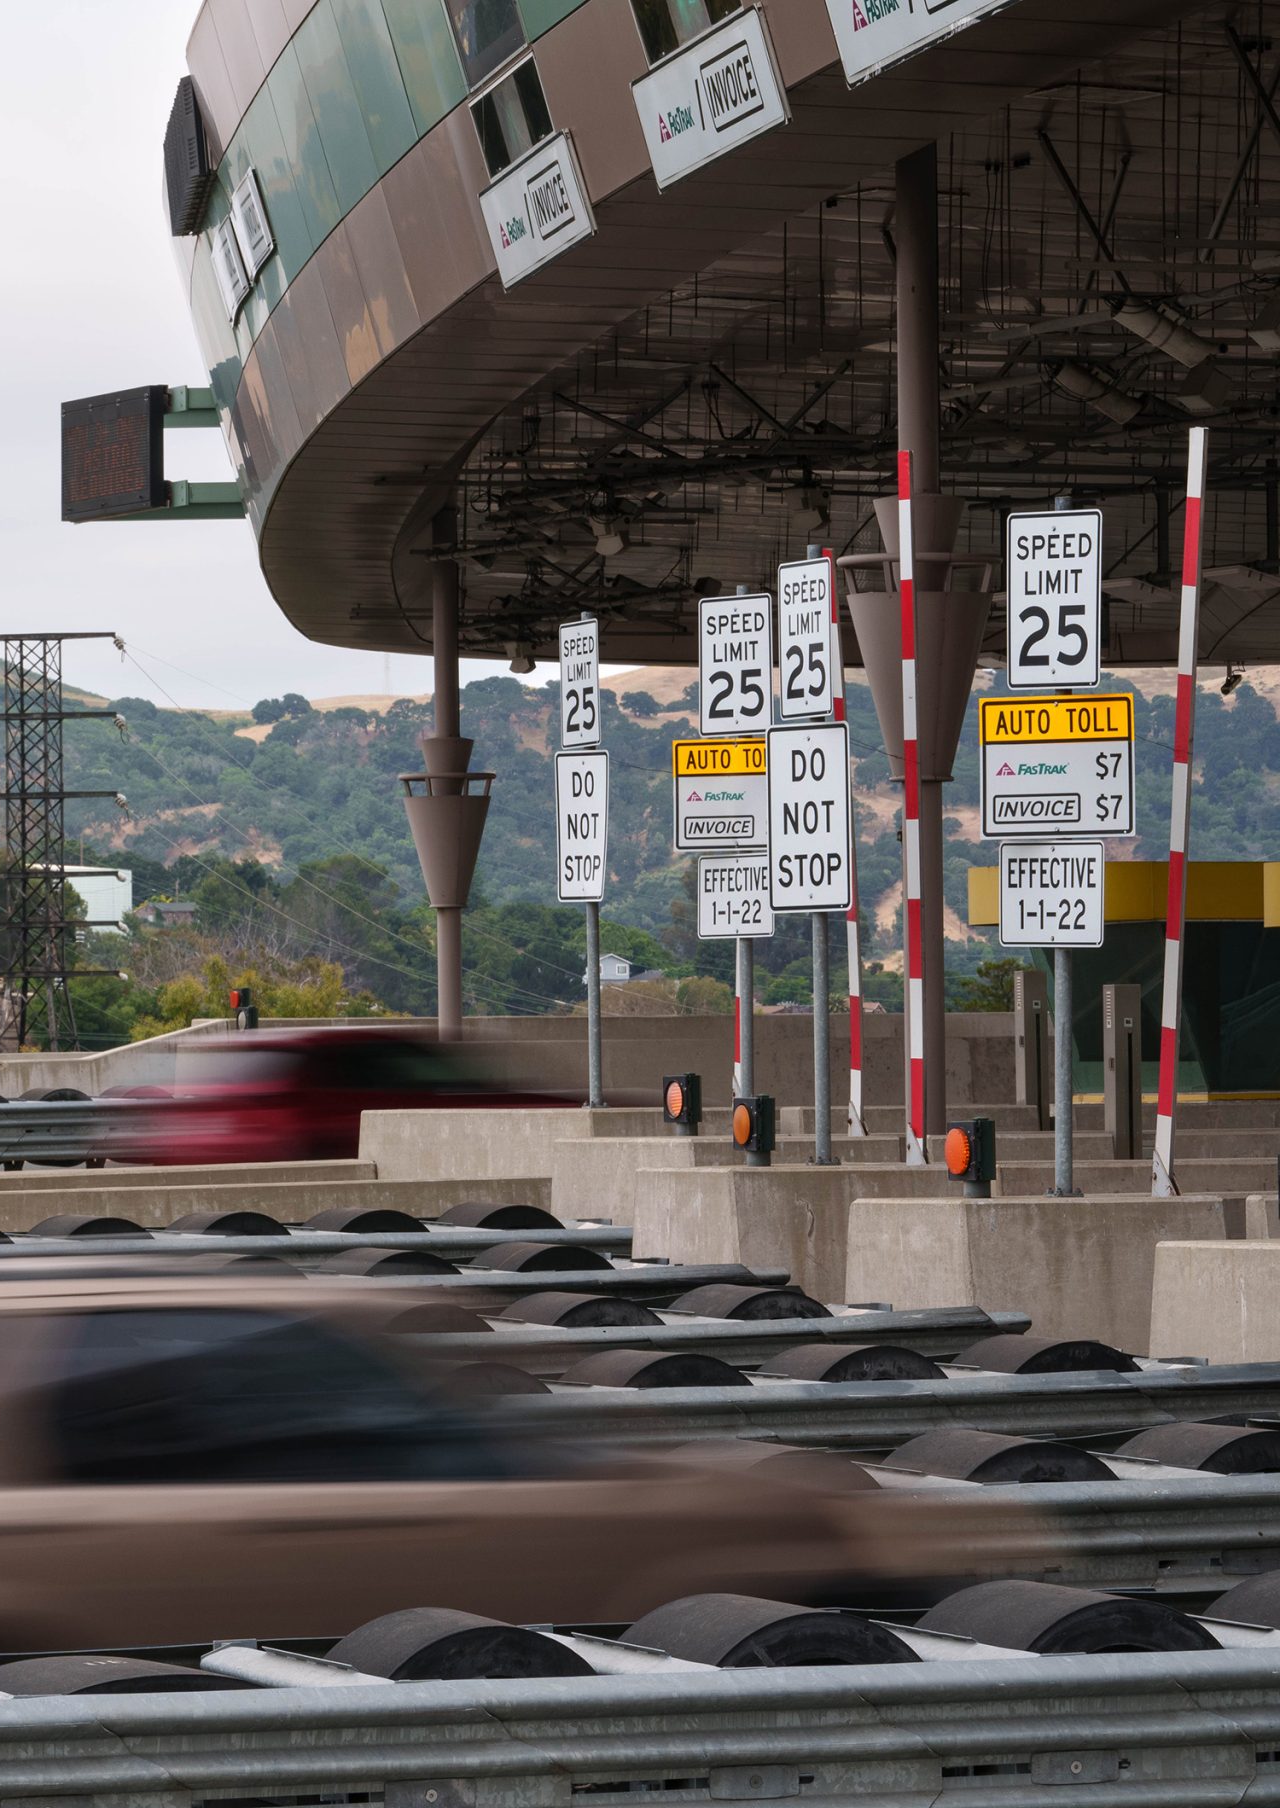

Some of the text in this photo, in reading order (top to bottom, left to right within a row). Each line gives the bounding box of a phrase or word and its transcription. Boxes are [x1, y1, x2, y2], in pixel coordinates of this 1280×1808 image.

[706, 54, 758, 119] INVOICE
[533, 172, 569, 228] INVOICE
[1016, 532, 1092, 561] SPEED
[783, 578, 826, 605] SPEED
[1024, 568, 1083, 596] LIMIT
[706, 612, 765, 636] SPEED
[788, 610, 822, 637] LIMIT
[1018, 604, 1089, 667] 25
[563, 636, 595, 658] SPEED
[713, 640, 759, 663] LIMIT
[567, 661, 592, 682] LIMIT
[785, 642, 826, 700] 25
[708, 668, 765, 719] 25
[565, 686, 596, 733] 25
[995, 706, 1119, 736] AUTO TOLL
[685, 748, 731, 770] AUTO
[791, 747, 826, 783] DO
[1095, 751, 1122, 780] $7
[571, 770, 595, 798] DO
[783, 800, 835, 836] NOT
[997, 793, 1123, 822] INVOICE $7
[567, 812, 599, 840] NOT
[688, 820, 751, 835] INVOICE
[564, 854, 601, 882] STOP
[704, 866, 768, 893] EFFECTIVE
[778, 852, 842, 888] STOP
[1007, 857, 1097, 889] EFFECTIVE
[712, 898, 762, 926] 1-1-22
[1018, 898, 1086, 930] 1-1-22
